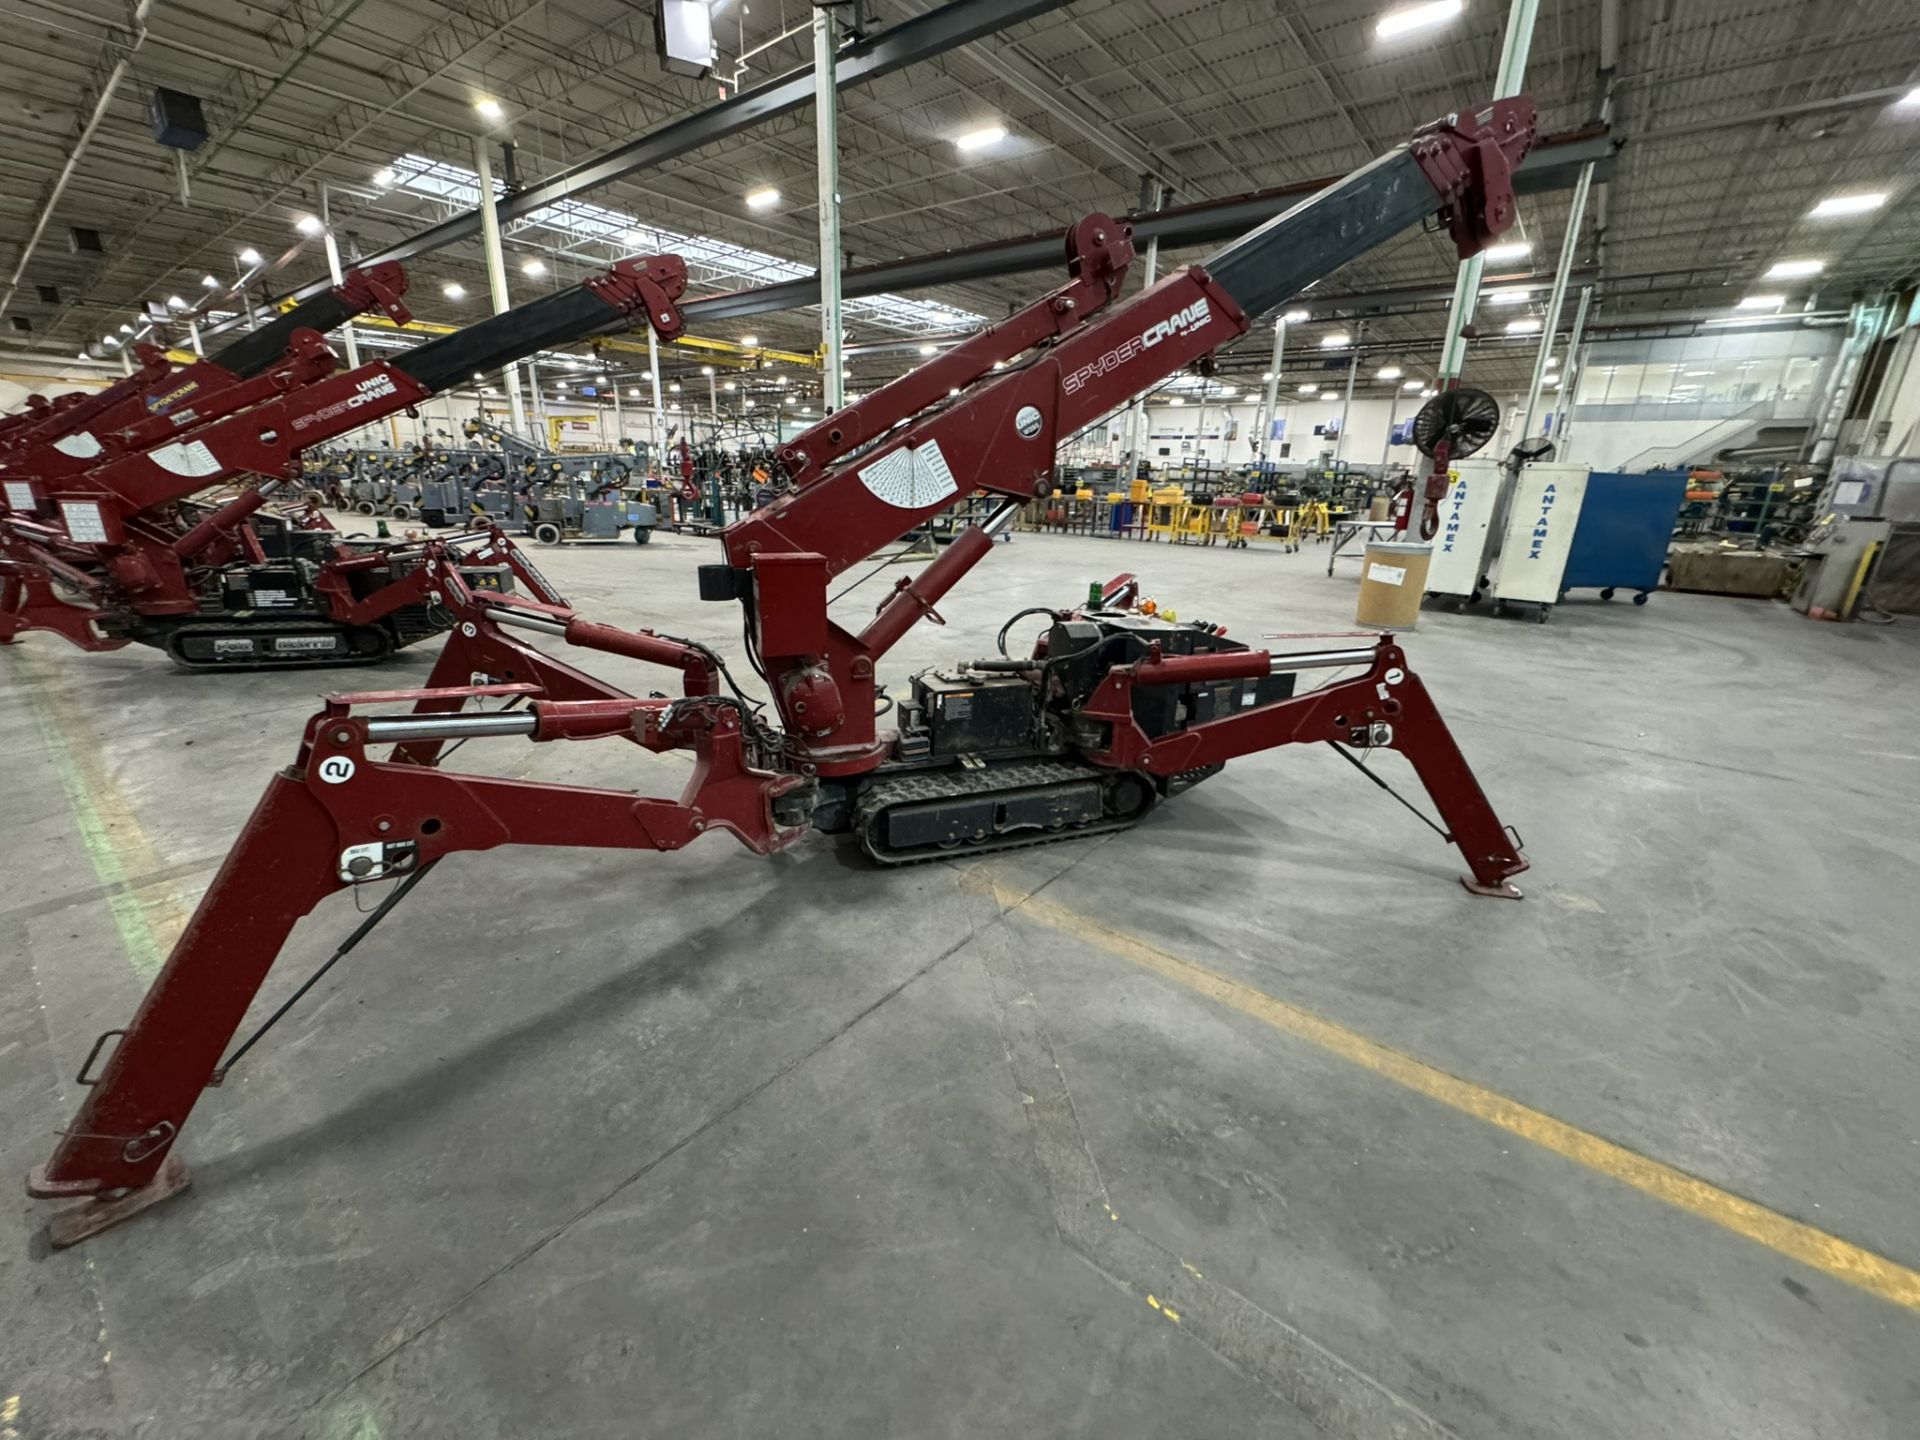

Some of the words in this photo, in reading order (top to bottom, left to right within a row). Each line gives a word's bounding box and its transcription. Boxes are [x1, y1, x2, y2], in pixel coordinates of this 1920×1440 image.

[1189, 314, 1212, 332] UNIC
[1062, 297, 1210, 396] SPYDERCRANE
[355, 373, 390, 392] UNIC
[291, 382, 398, 431] SPYDERCRANE
[1443, 480, 1467, 552] ANTAMEX
[1528, 484, 1557, 559] ANTAMEX
[464, 624, 475, 635] 3
[325, 762, 350, 778] 2
